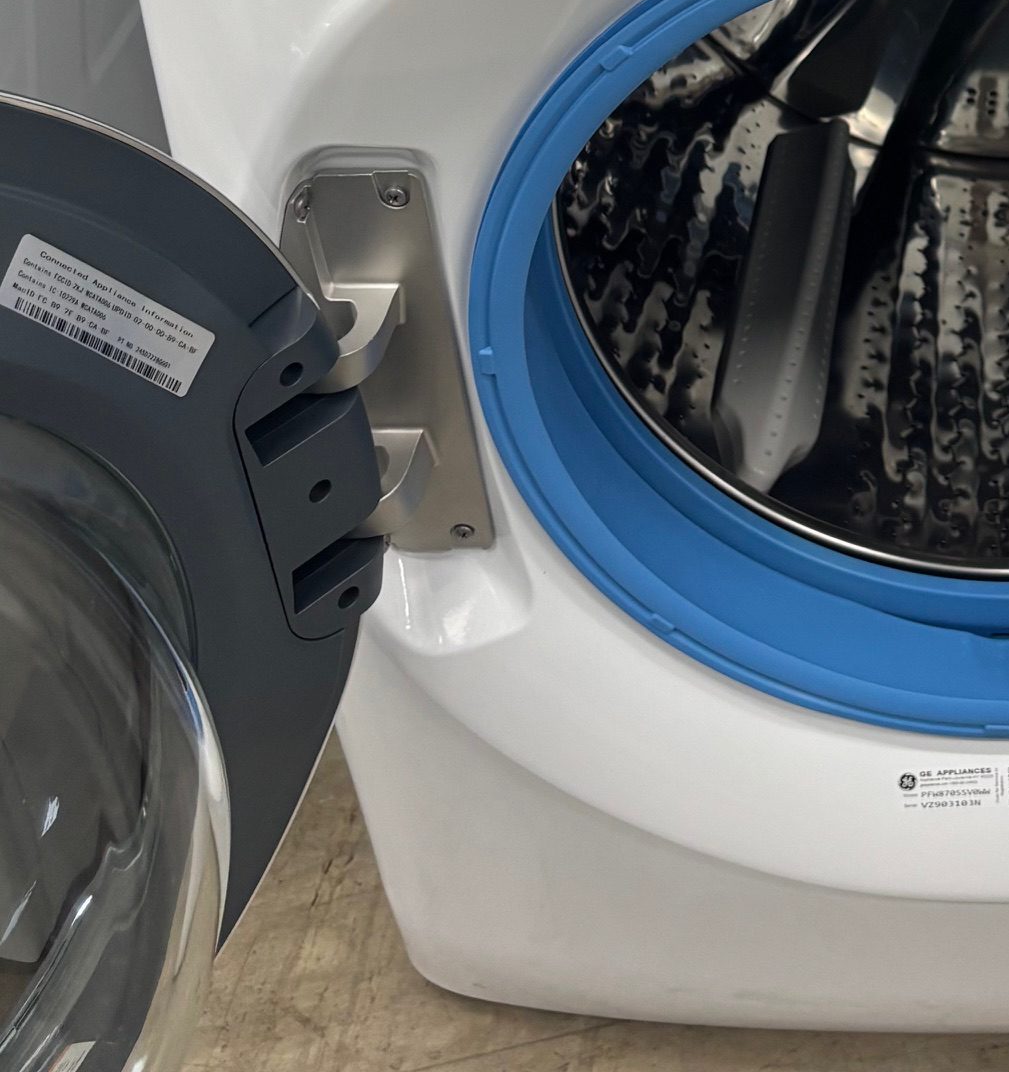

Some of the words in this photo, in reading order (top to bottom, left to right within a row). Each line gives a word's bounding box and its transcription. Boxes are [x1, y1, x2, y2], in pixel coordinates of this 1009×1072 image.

[23, 257, 51, 277] Contains
[17, 269, 47, 289] Contains
[40, 250, 89, 281] Connected
[92, 279, 137, 307] Appliance
[141, 305, 194, 338] Information
[936, 768, 992, 776] APPLIANCES
